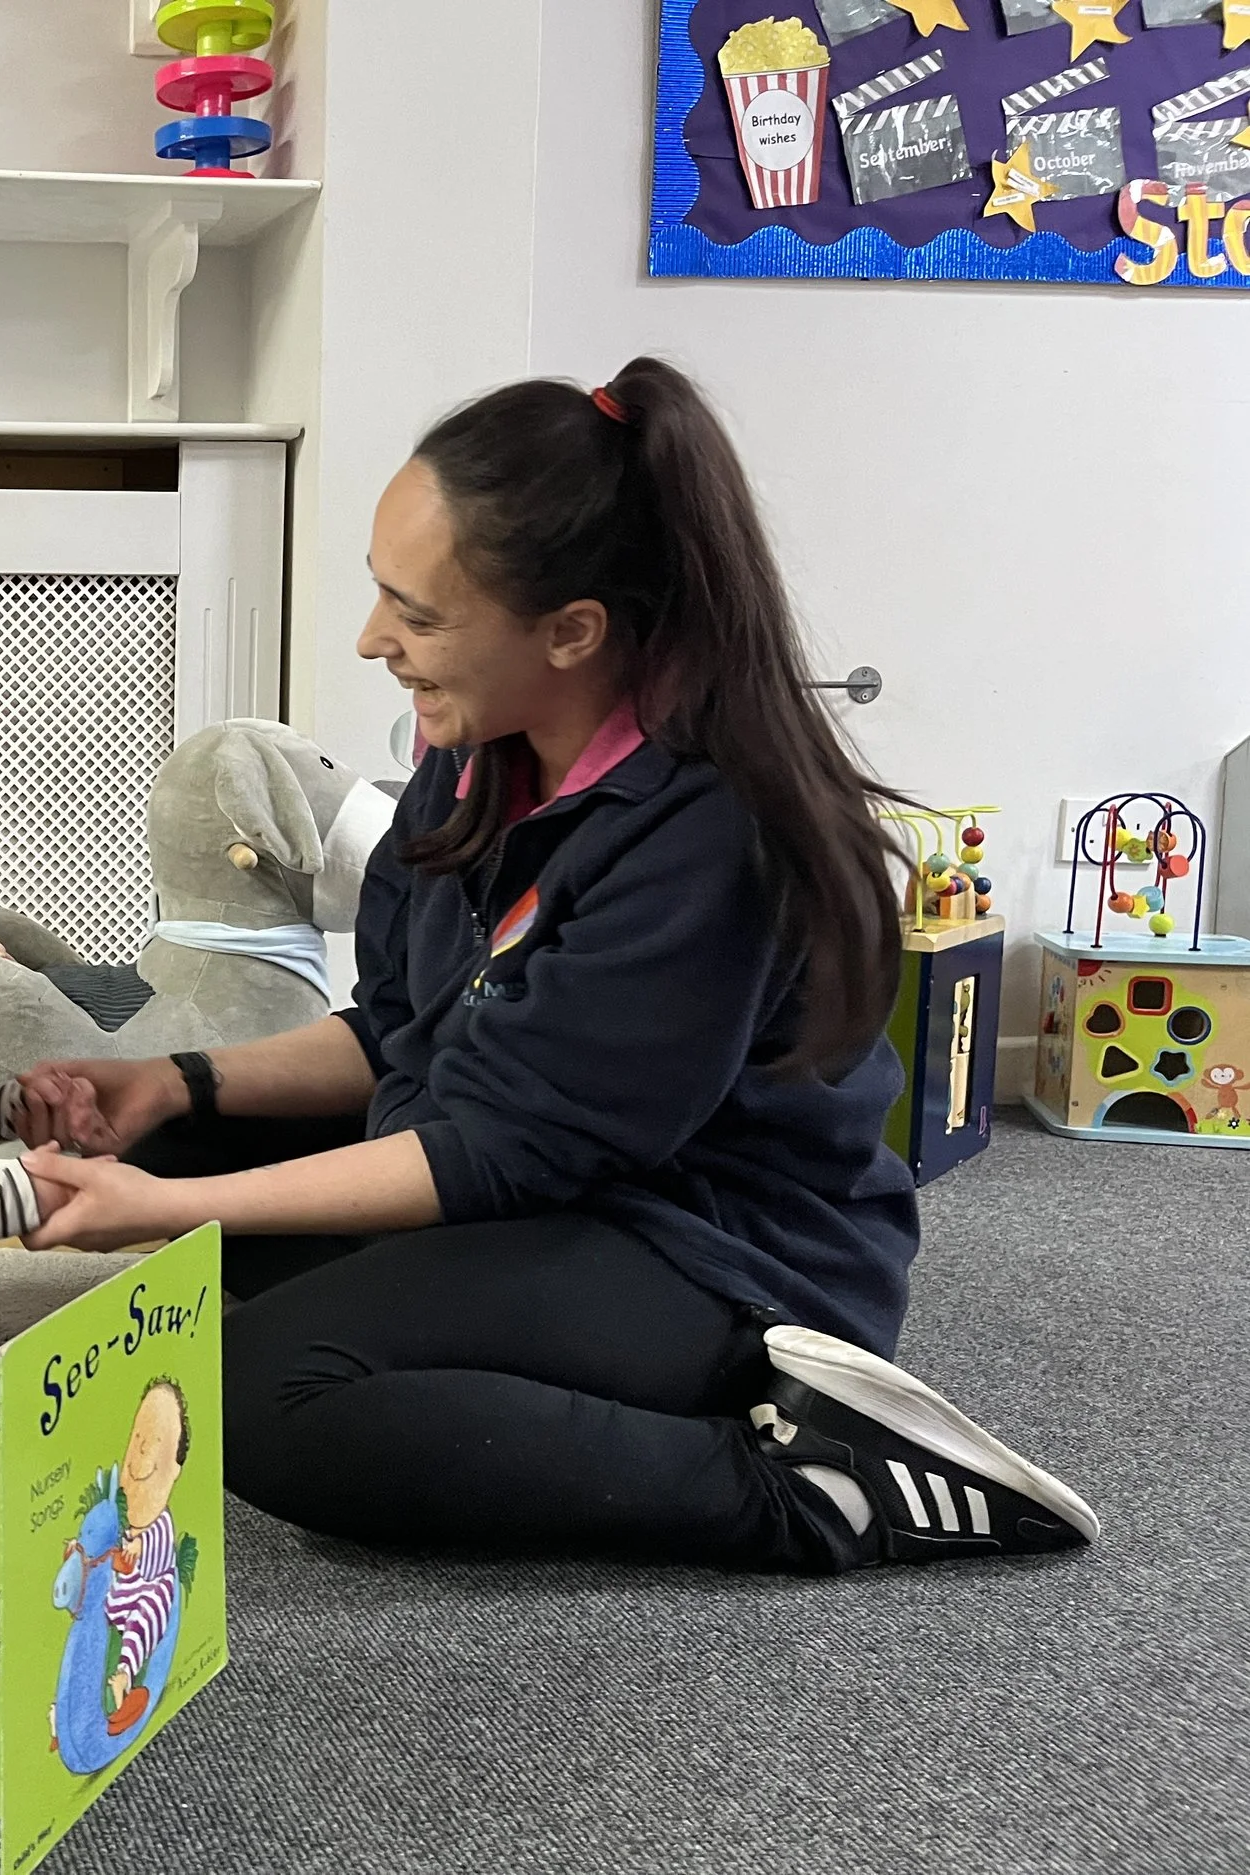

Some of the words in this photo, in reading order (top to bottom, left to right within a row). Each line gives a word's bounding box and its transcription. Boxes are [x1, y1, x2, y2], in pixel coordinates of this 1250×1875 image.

[751, 113, 801, 127] Birthday
[759, 132, 797, 146] wishes
[859, 138, 947, 169] September
[1034, 152, 1096, 171] October
[1173, 153, 1250, 178] Novembe
[40, 1283, 207, 1436] See-Saw!
[30, 1457, 72, 1502] Nursery
[30, 1495, 67, 1533] Songs
